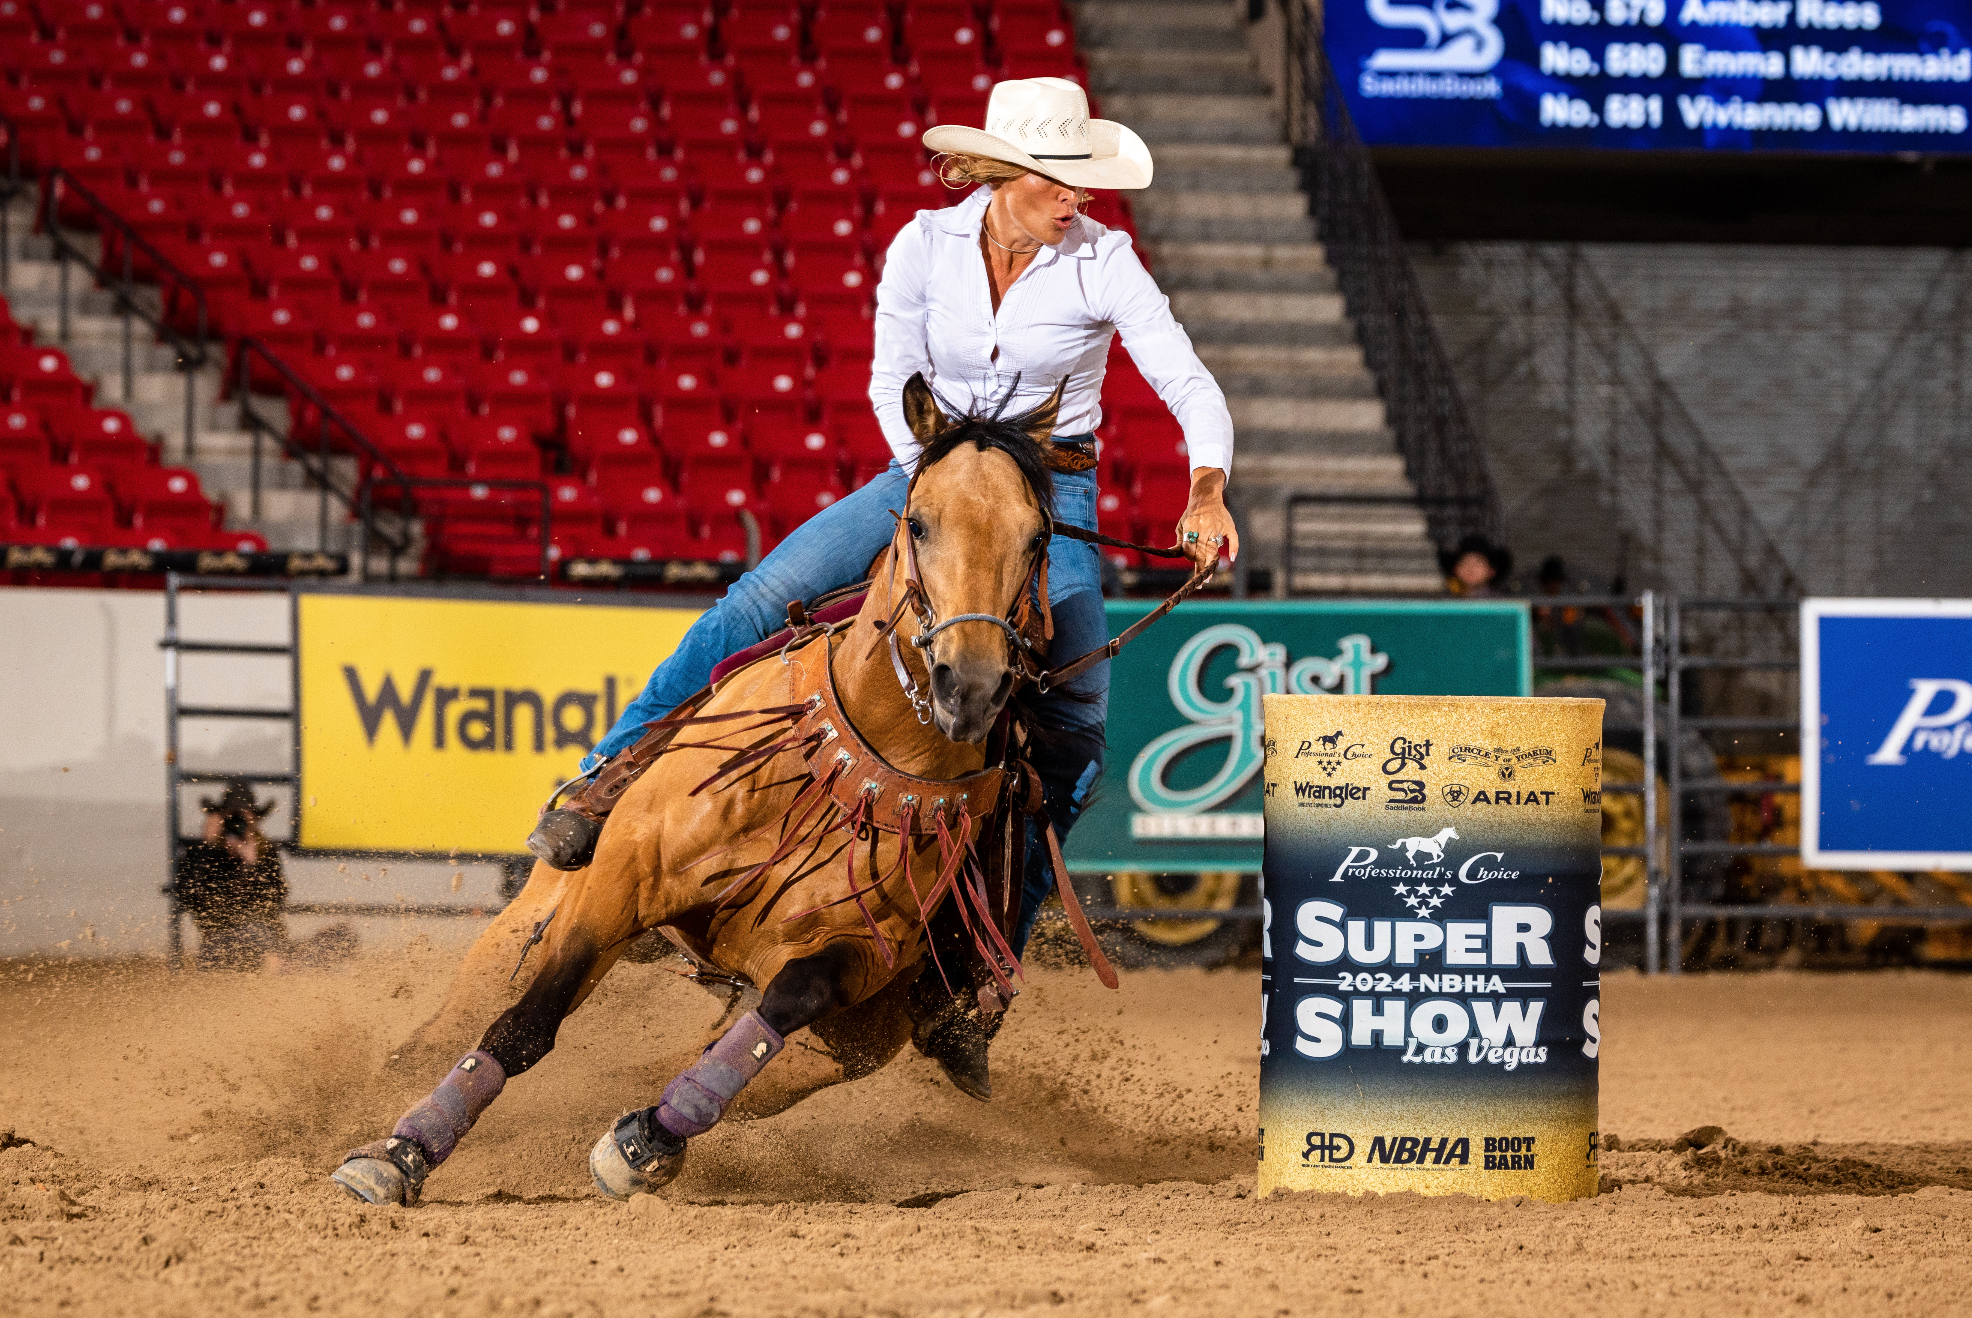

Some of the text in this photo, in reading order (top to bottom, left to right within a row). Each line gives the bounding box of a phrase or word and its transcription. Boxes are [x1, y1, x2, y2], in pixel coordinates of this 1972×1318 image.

[1678, 0, 1793, 28] Amber
[1796, 0, 1881, 29] Rees
[1540, 41, 1600, 76] No.
[1678, 43, 1786, 79] Emma
[1789, 45, 1972, 81] Mcdermaid
[1540, 93, 1600, 127] No.
[1677, 94, 1822, 131] Vivianne
[1826, 97, 1968, 133] Williams
[341, 664, 632, 796] Wrangl
[1343, 743, 1373, 761] Choice
[1382, 737, 1433, 775] Gist
[1452, 746, 1491, 759] CIRCLE
[1515, 748, 1553, 762] YOAKUM
[1294, 781, 1371, 808] Wrangler
[1385, 804, 1426, 812] SaddleBook
[1472, 790, 1556, 806] ARIAT
[1329, 846, 1520, 884] Professional's Choice
[1294, 900, 1555, 967] SUPER
[1419, 974, 1507, 994] NBHA
[1294, 996, 1546, 1060] SHOW
[1402, 1037, 1548, 1071] Las Vegas
[1366, 1135, 1471, 1165] NBHA
[1484, 1136, 1536, 1153] BOOT
[1484, 1154, 1536, 1171] BARN
